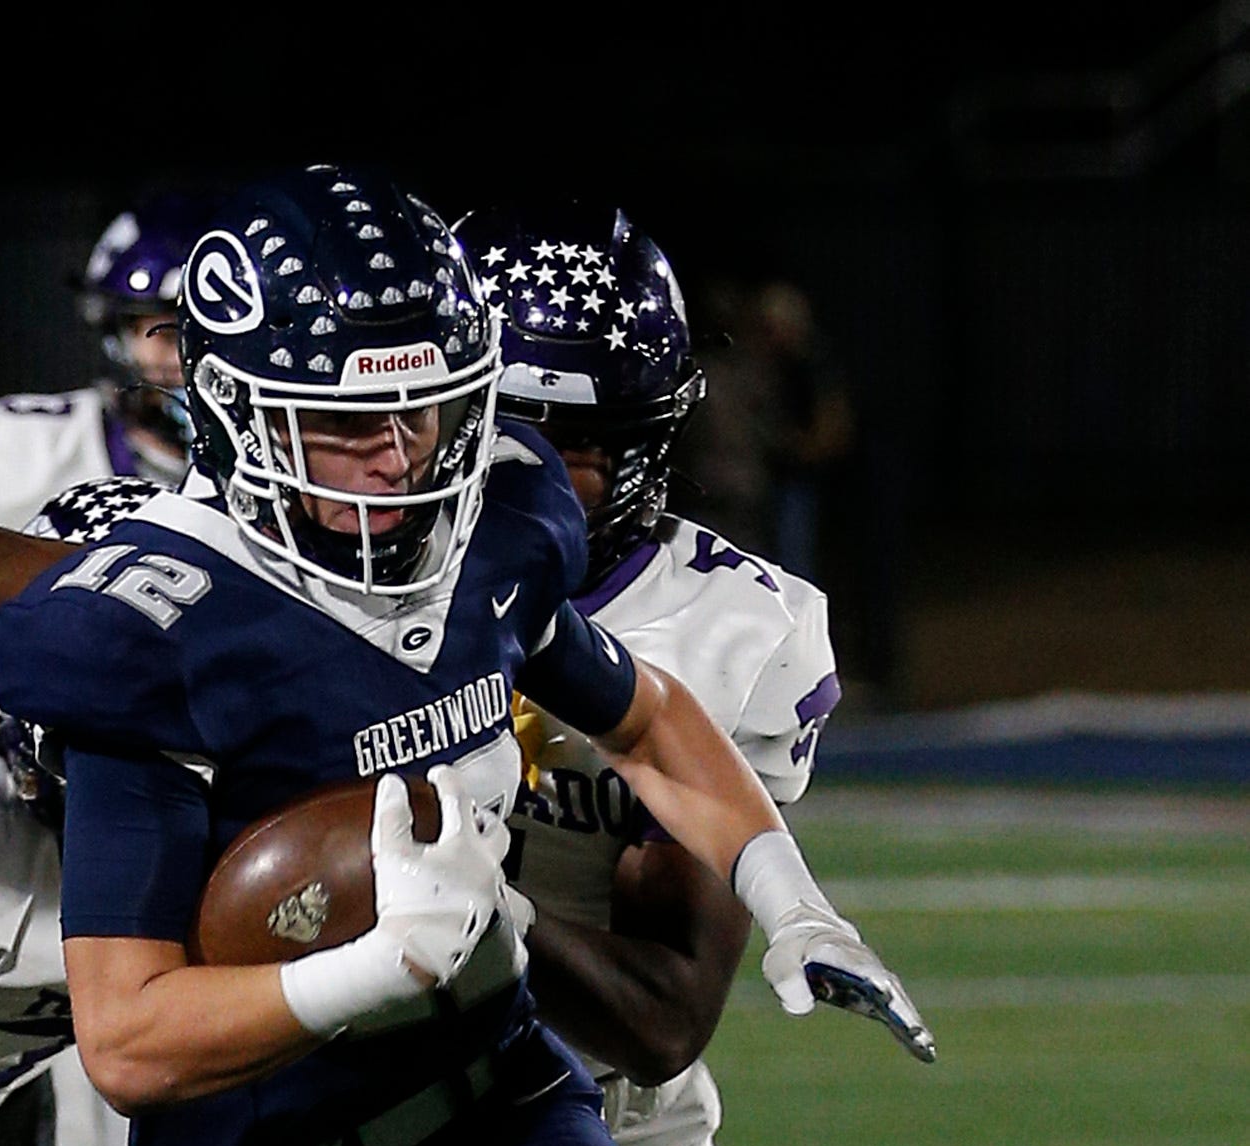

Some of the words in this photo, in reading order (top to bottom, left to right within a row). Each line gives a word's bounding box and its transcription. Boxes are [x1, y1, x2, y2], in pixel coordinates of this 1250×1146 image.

[357, 348, 436, 374] Riddell
[50, 544, 213, 631] 12
[353, 671, 508, 778] GREENWOOD
